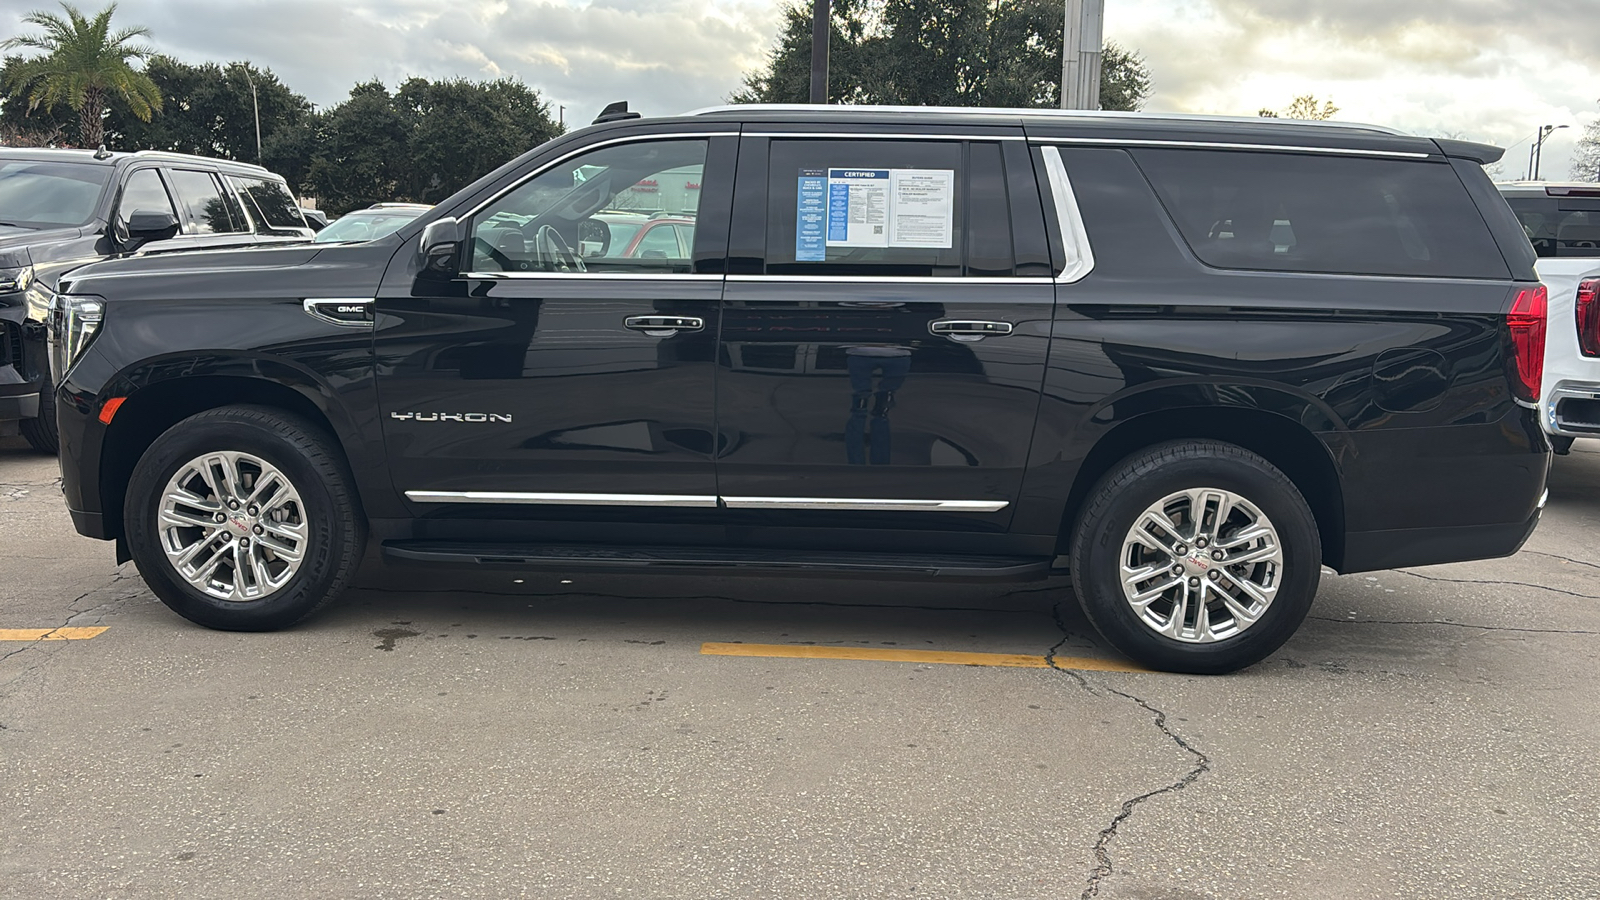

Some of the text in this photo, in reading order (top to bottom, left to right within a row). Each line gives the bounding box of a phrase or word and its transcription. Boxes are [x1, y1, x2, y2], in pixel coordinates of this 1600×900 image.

[391, 412, 512, 423] YUKON
[229, 516, 248, 531] GMC
[1188, 556, 1208, 570] GMC
